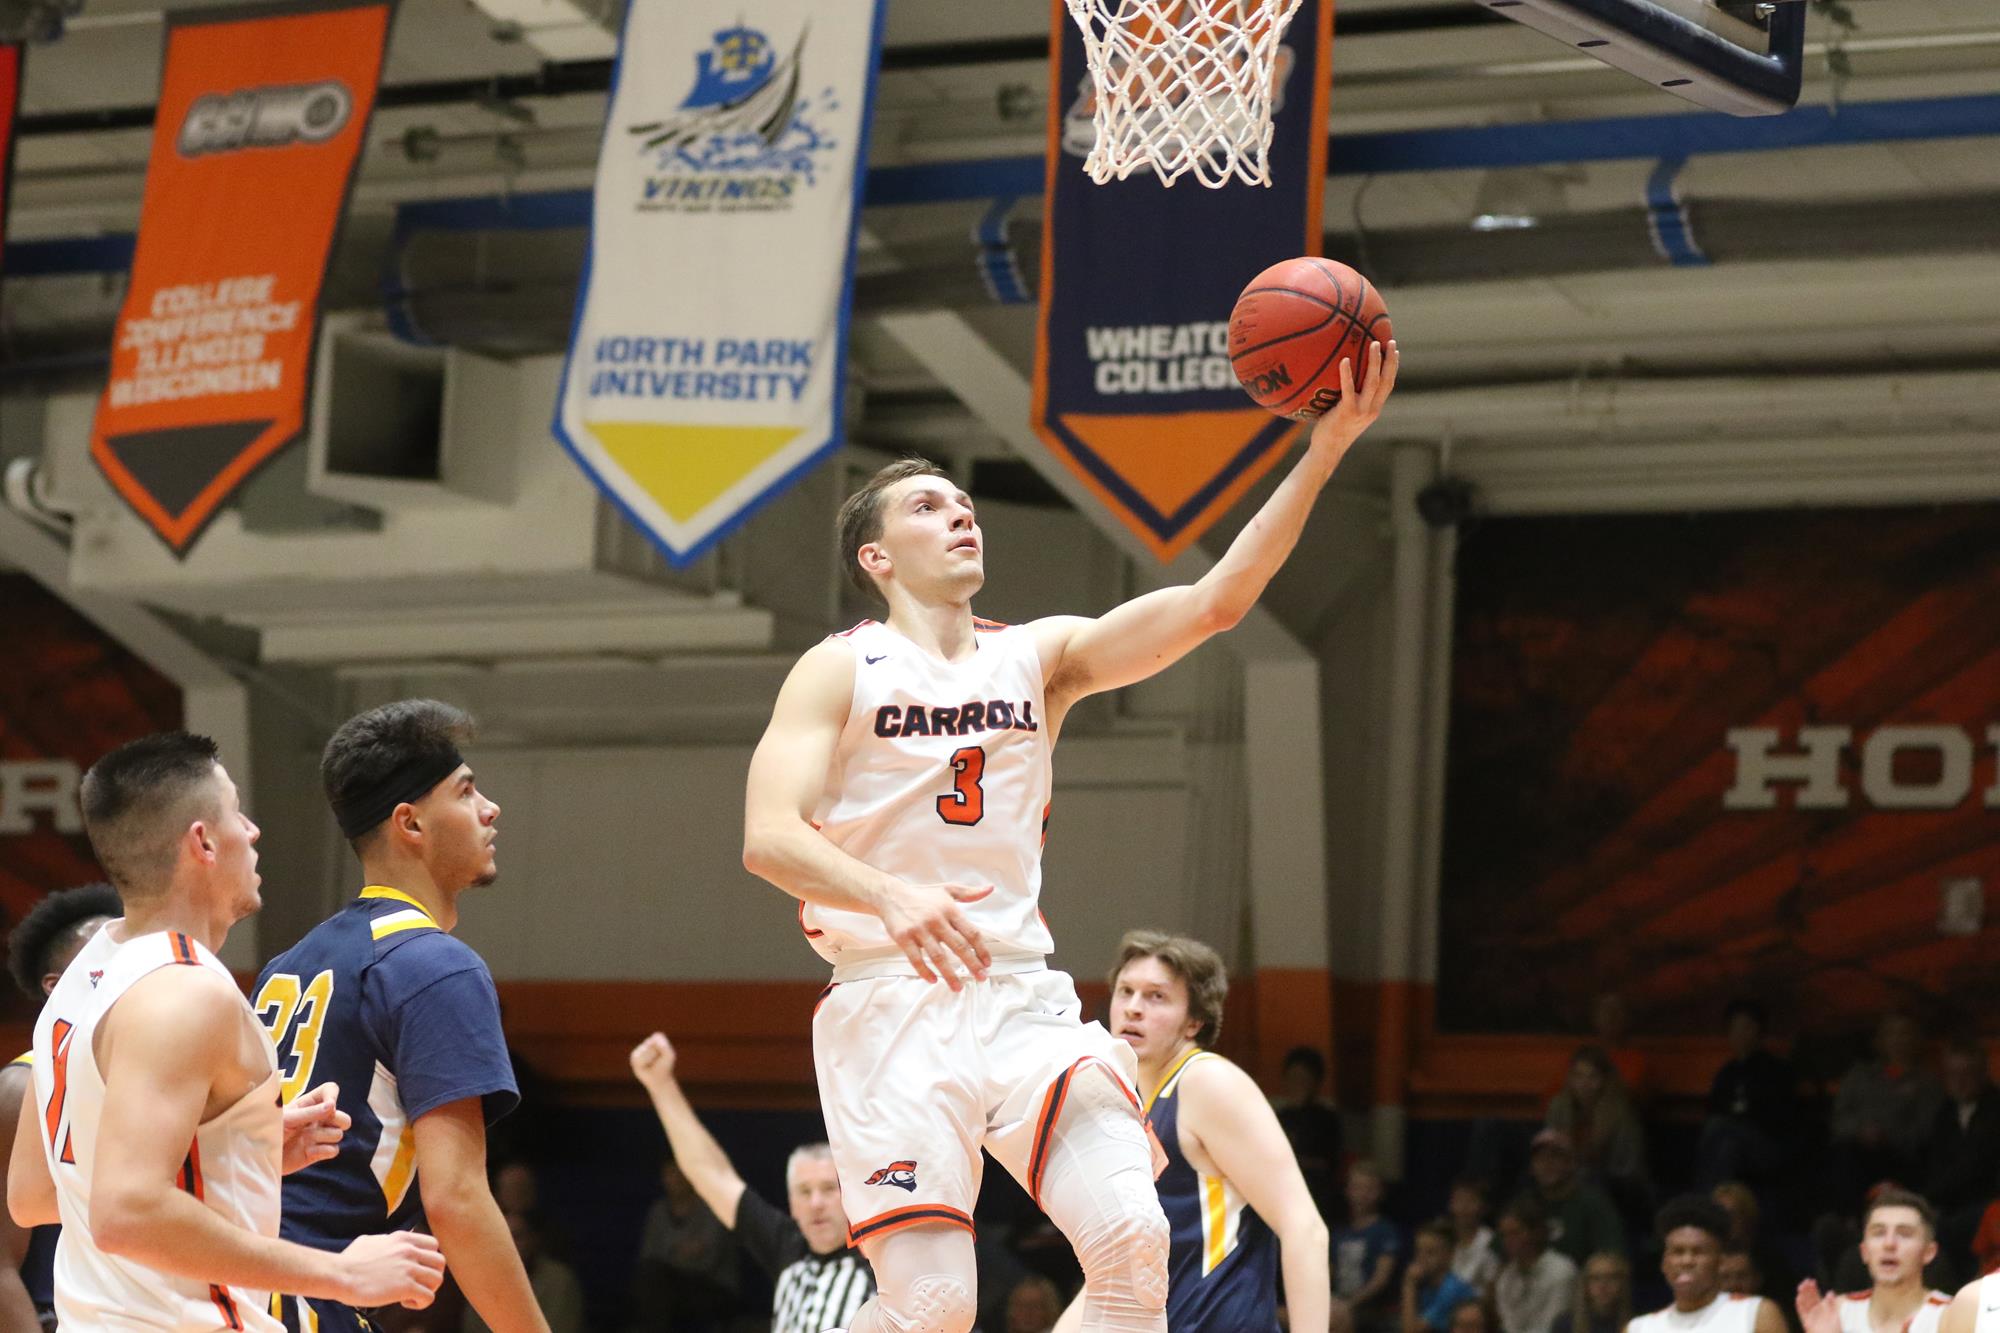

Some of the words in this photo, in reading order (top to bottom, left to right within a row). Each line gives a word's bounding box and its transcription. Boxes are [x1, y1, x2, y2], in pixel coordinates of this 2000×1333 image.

[643, 175, 797, 200] VIKINGS
[152, 274, 277, 318] COLLEGE
[715, 338, 814, 368] PARK
[1086, 321, 1230, 361] WHEATO
[873, 699, 1038, 739] CARROLL
[936, 745, 986, 827] 3
[1722, 723, 2000, 811] HO
